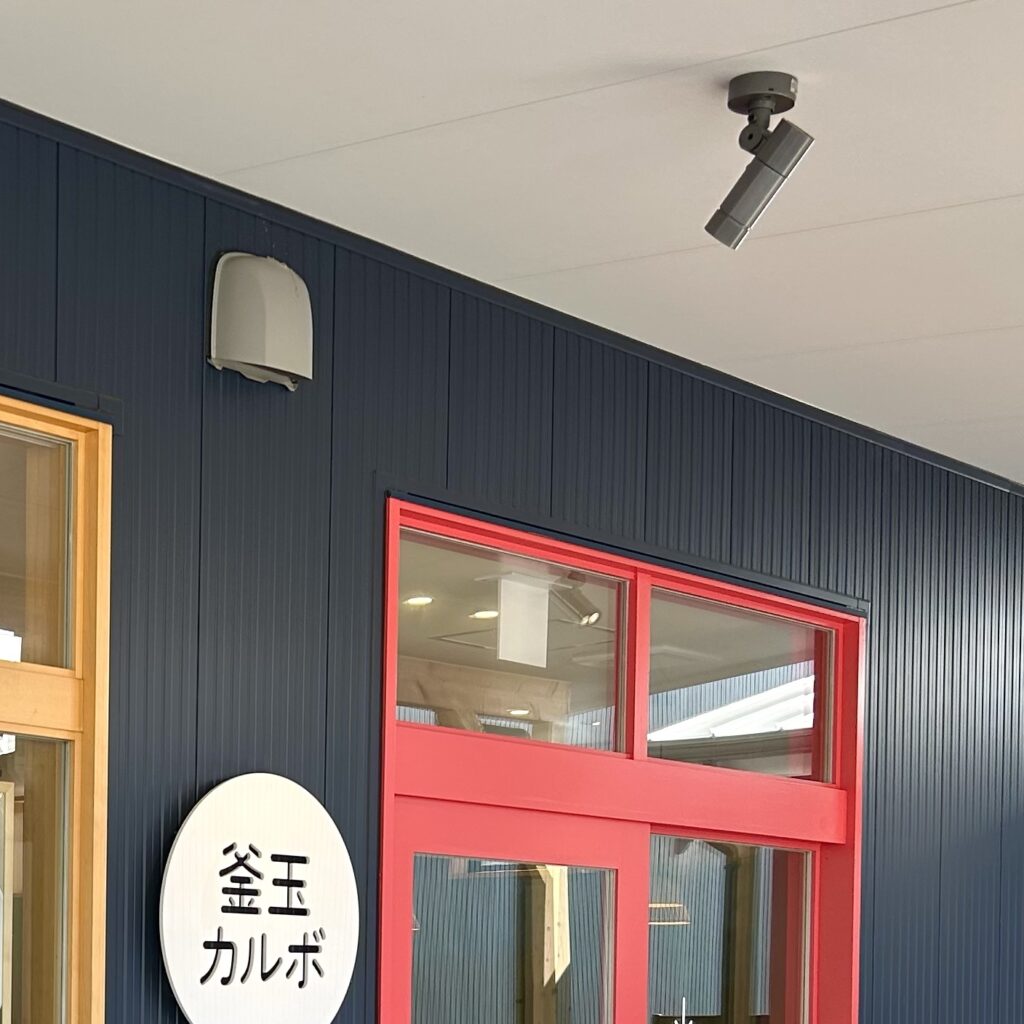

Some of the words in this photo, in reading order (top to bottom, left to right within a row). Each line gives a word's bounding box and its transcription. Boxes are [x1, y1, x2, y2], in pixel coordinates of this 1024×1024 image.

[219, 841, 311, 917] 釜玉
[200, 926, 327, 989] カルボ
